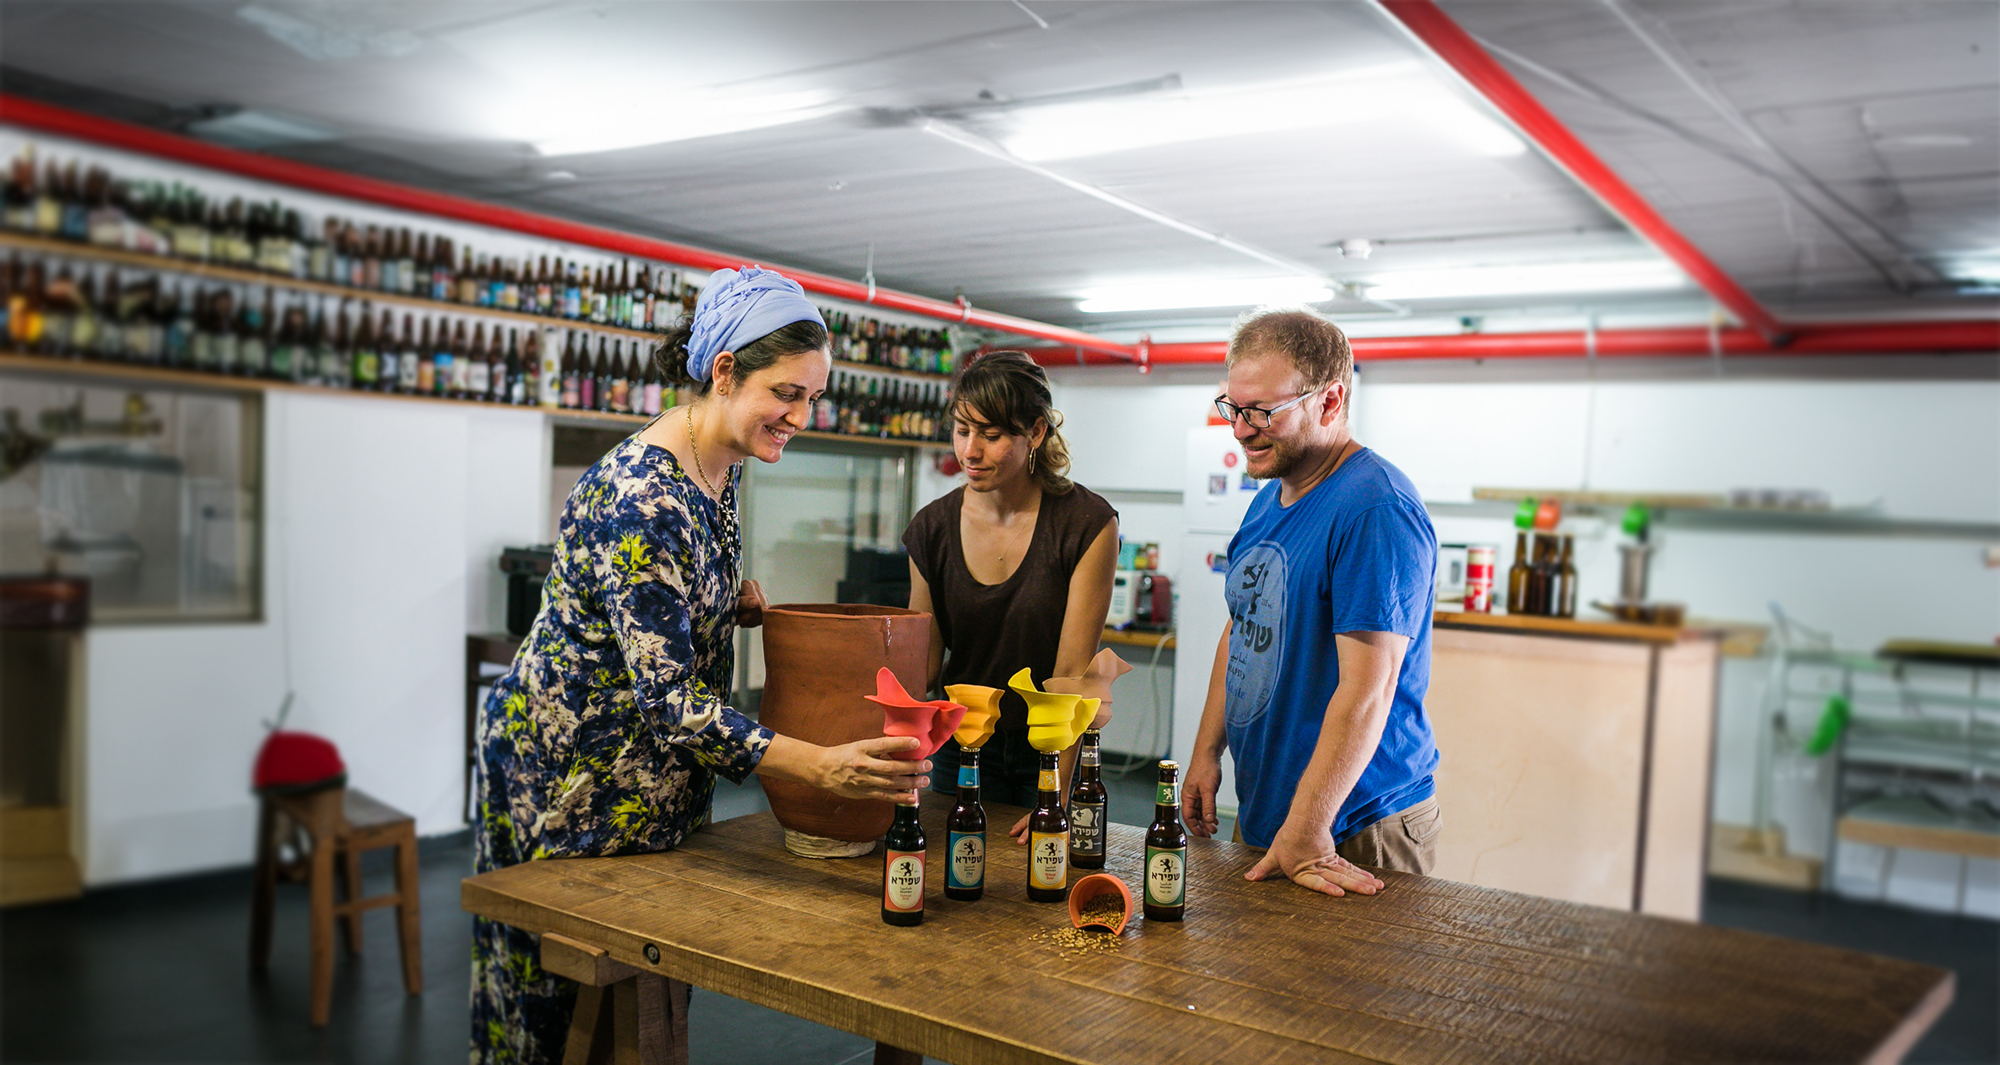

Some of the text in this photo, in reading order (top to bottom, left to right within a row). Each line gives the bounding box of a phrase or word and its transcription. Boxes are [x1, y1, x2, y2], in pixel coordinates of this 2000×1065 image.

[1072, 826, 1099, 836] שפירא
[955, 855, 982, 864] שפירא
[1036, 856, 1064, 864] שפירא
[891, 876, 921, 885] שפירא
[1151, 872, 1181, 881] שפירא
